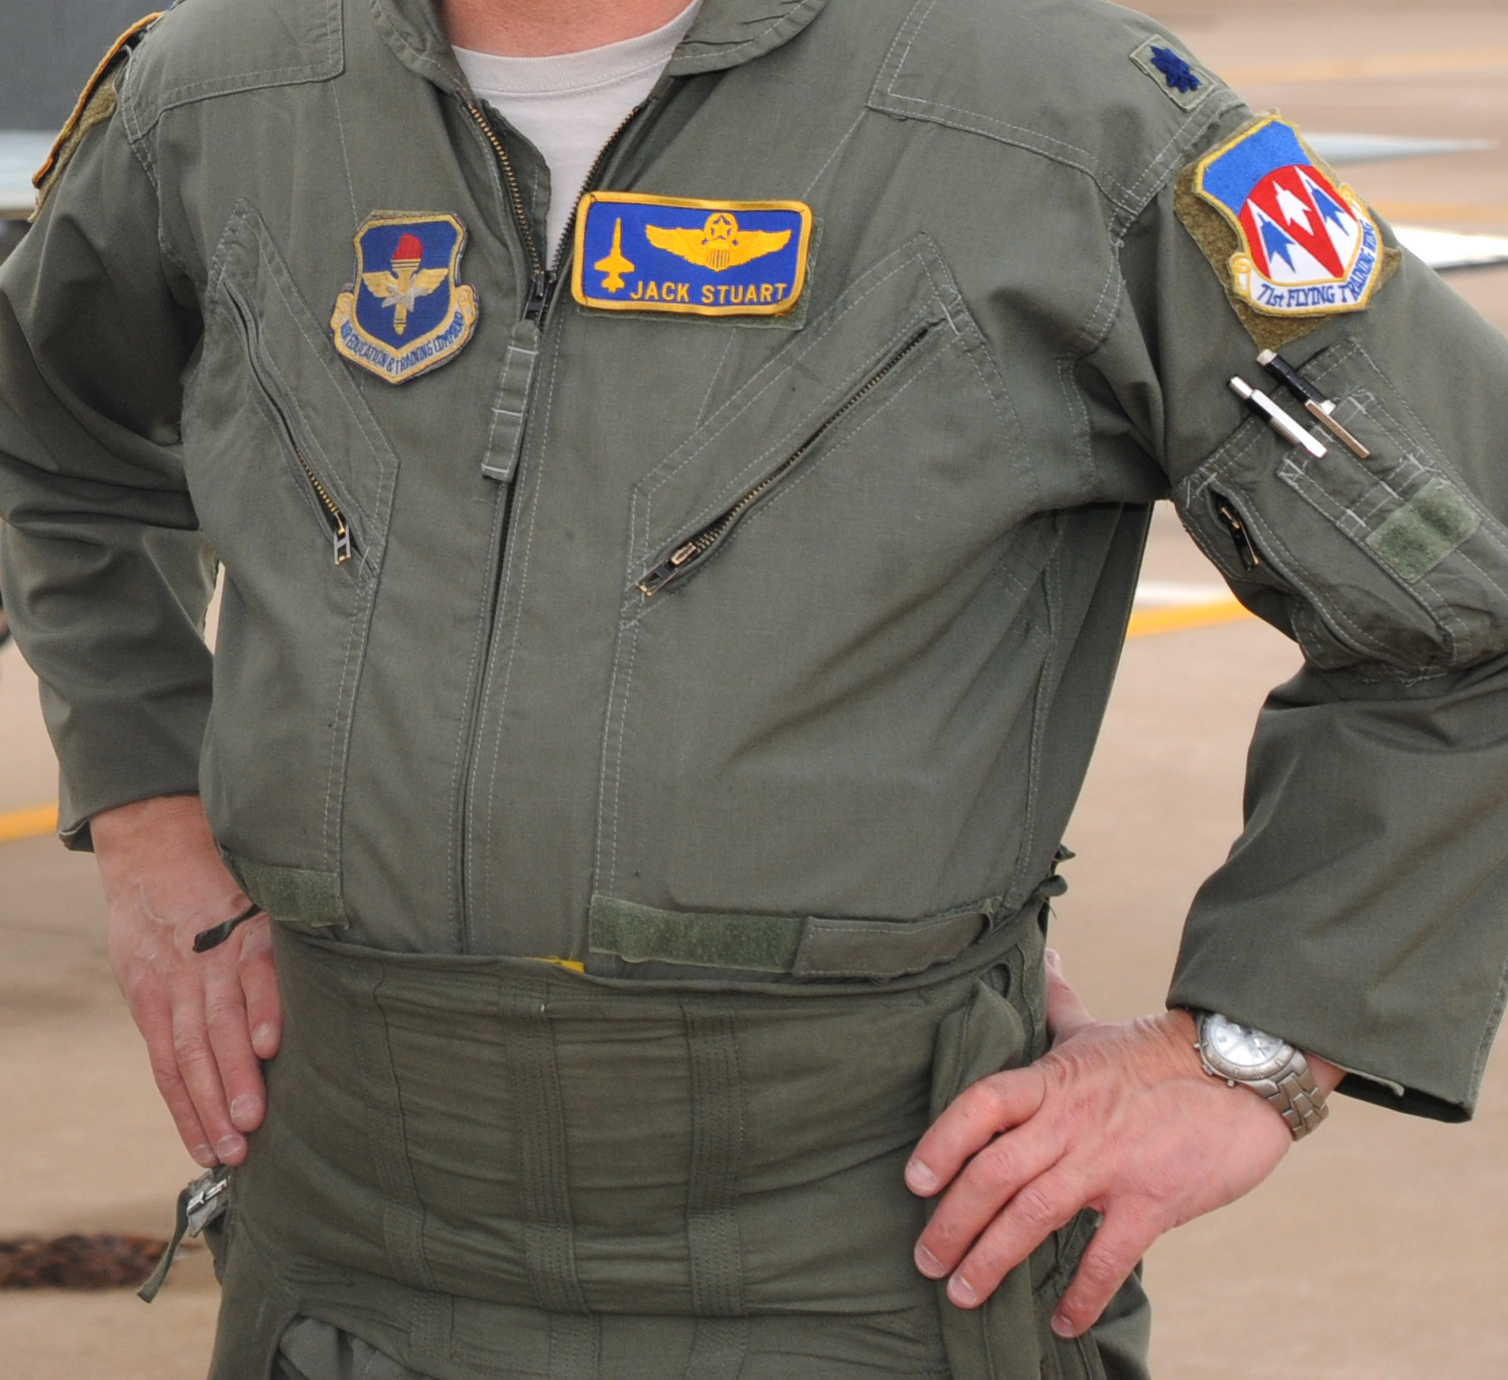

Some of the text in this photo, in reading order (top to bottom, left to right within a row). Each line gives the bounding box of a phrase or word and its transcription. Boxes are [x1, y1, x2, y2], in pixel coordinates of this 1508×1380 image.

[630, 280, 788, 305] JACK STUART
[1257, 283, 1285, 307] 71st
[1286, 284, 1336, 308] FLYING
[1337, 247, 1376, 303] TRAINING
[346, 333, 388, 368] EDUCATION
[394, 340, 434, 375] TRAINING
